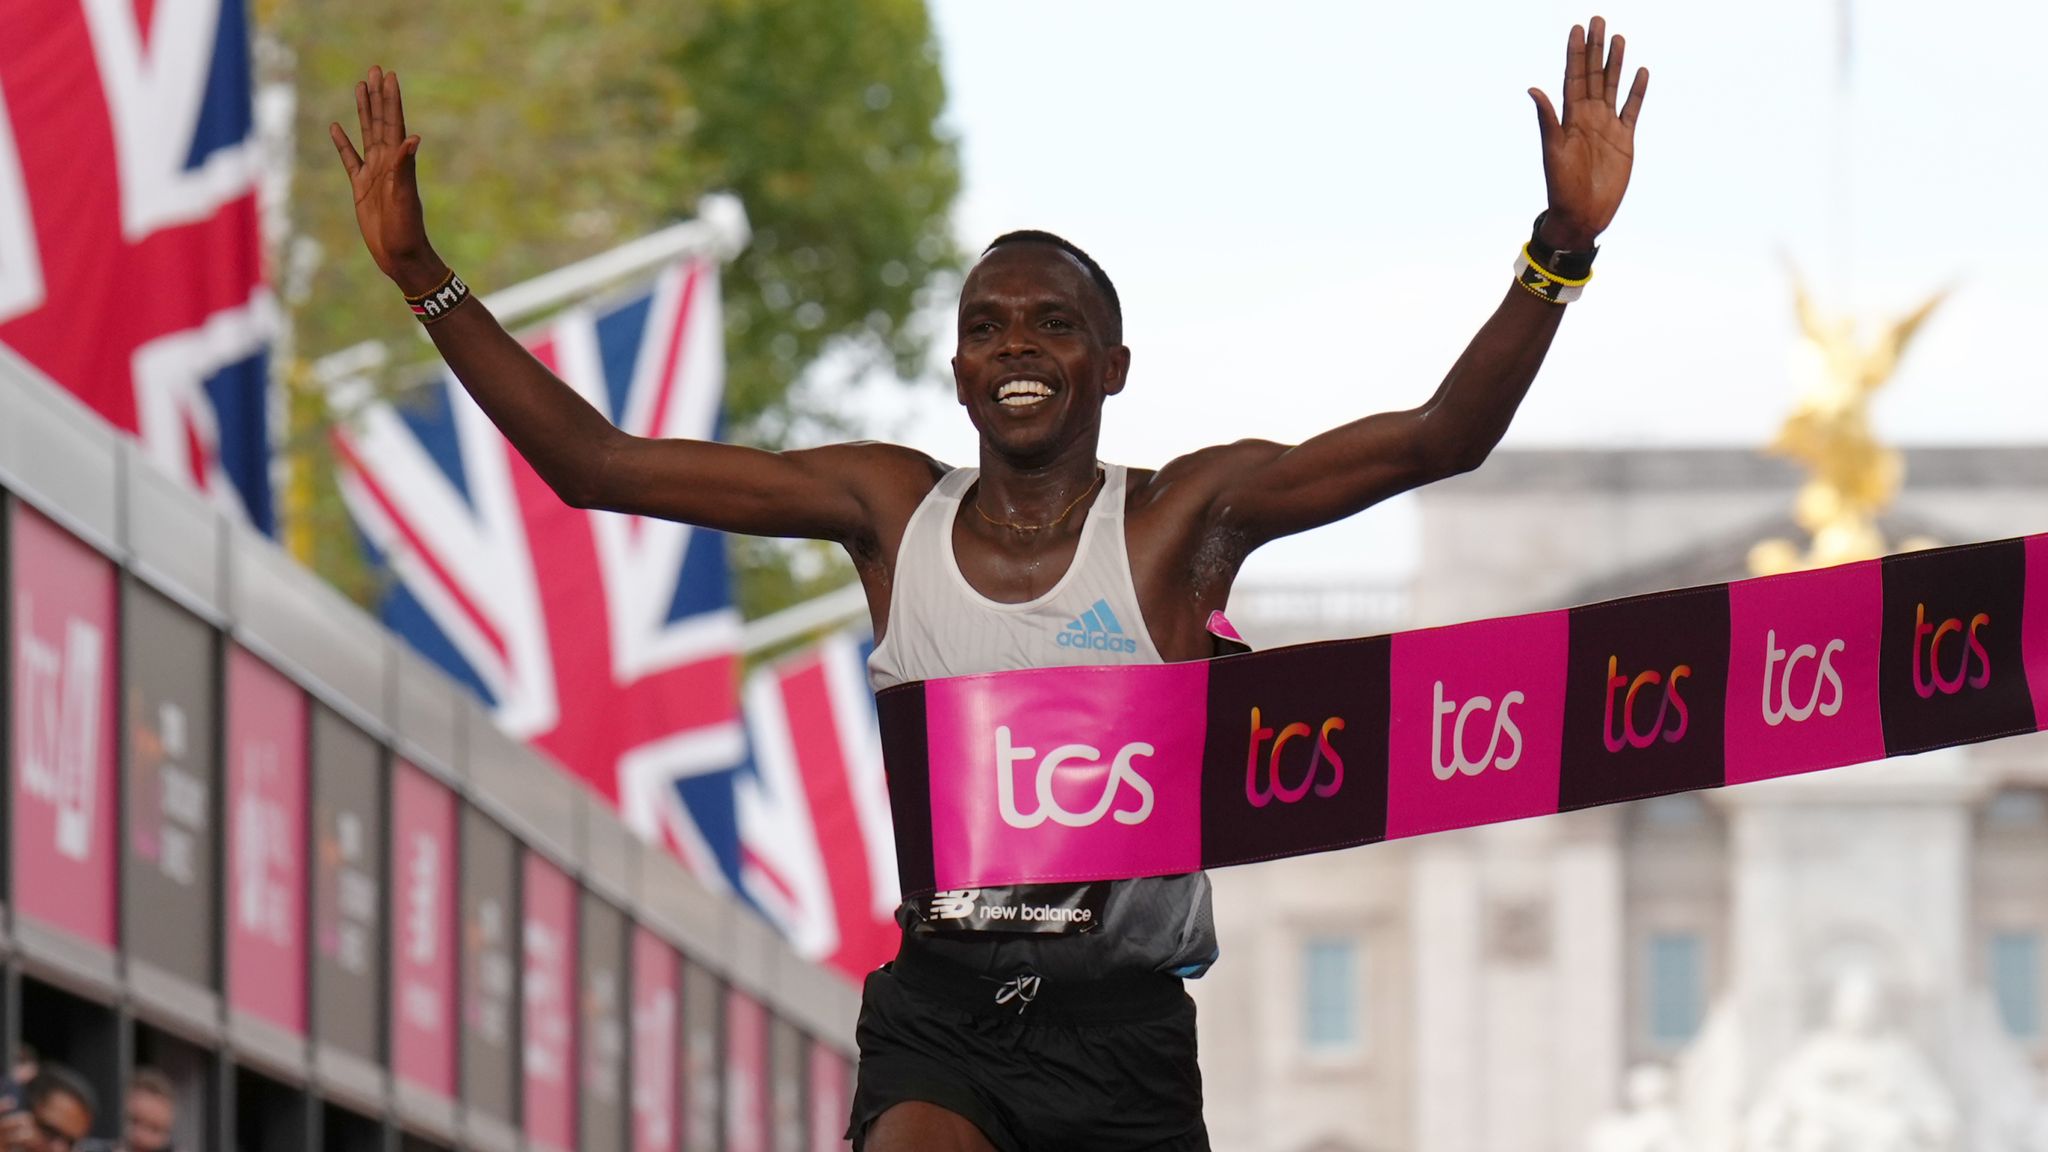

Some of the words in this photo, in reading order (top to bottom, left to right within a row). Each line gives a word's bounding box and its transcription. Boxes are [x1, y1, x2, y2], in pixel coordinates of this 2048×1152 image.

[1055, 631, 1137, 654] adidas
[1762, 629, 1844, 726] tcs
[1913, 603, 1990, 698] tcs
[1431, 680, 1525, 781] tcs
[1603, 655, 1691, 753] tcs
[995, 725, 1154, 829] tcs
[1246, 707, 1345, 807] tcs
[979, 905, 1018, 919] new
[1020, 903, 1092, 922] balance
